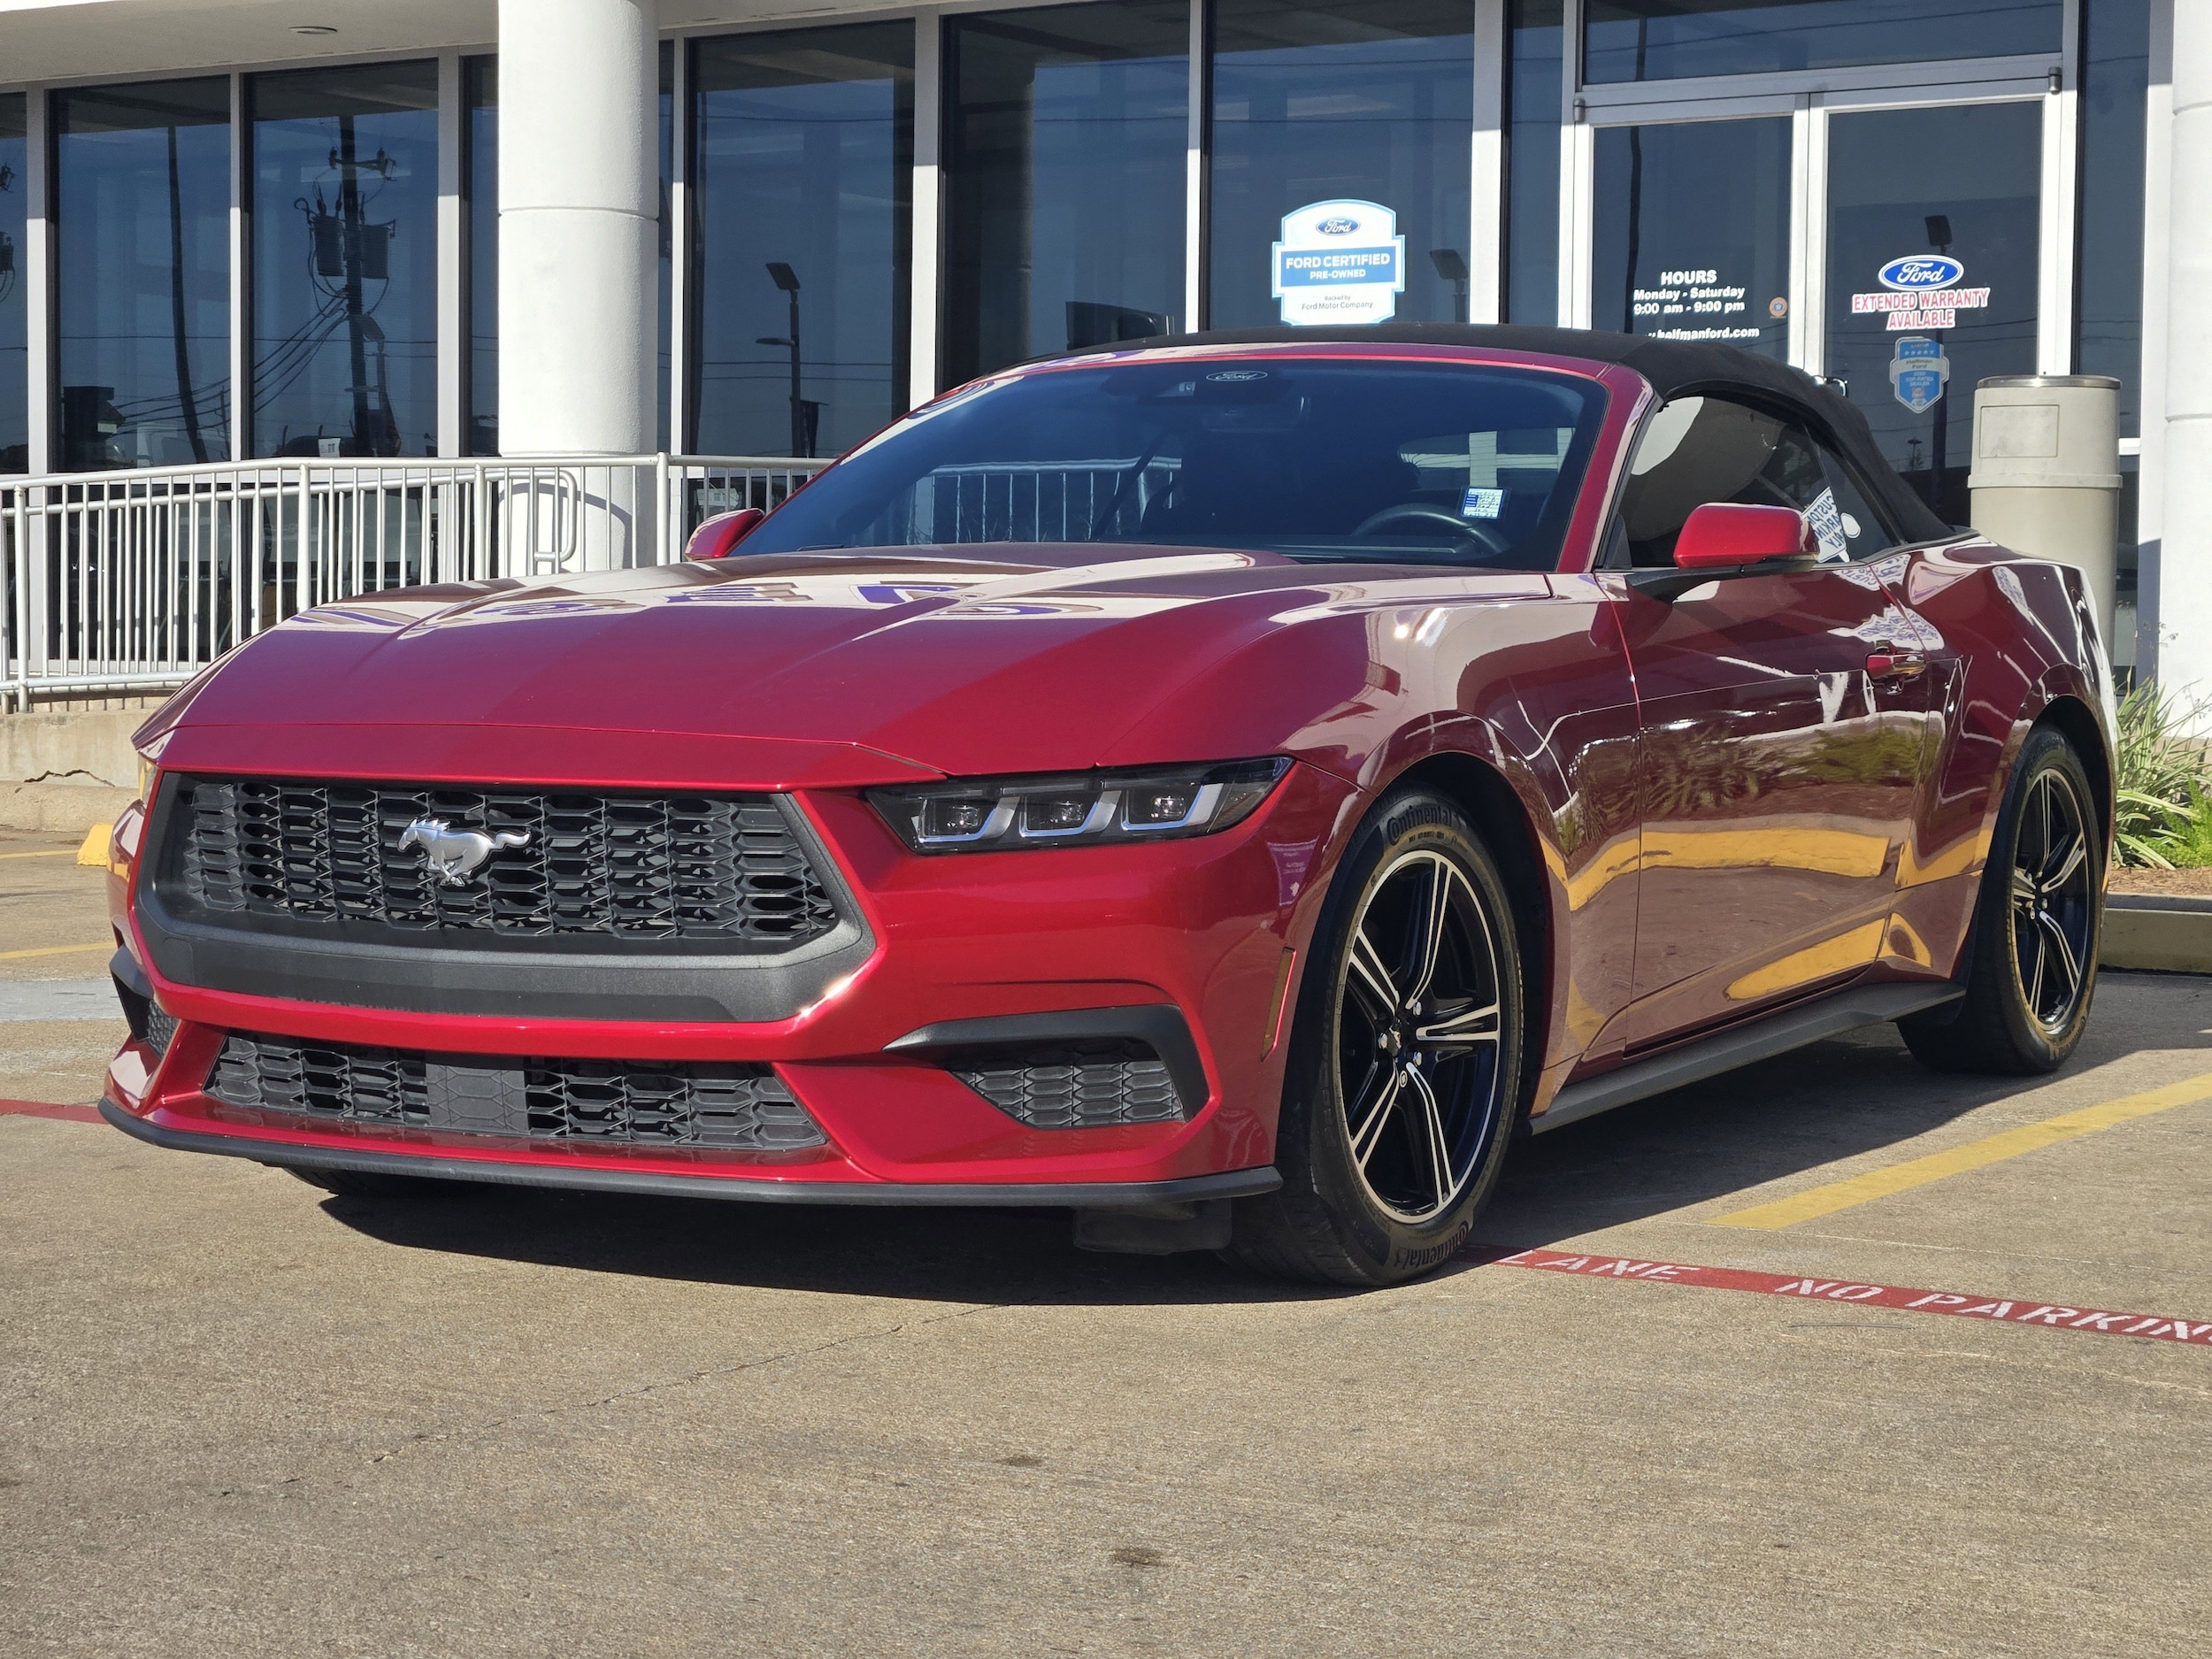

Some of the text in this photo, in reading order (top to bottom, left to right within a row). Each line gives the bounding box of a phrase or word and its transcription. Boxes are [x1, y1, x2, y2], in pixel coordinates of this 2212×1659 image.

[1286, 253, 1391, 270] FORD CERTIFIED
[1310, 269, 1366, 280] PRE-OWNED
[1660, 269, 1717, 286] HOURS
[1896, 261, 1946, 284] Ford
[1633, 288, 1681, 302] Monday
[1690, 286, 1745, 299] Saturday
[1854, 289, 1990, 311] EXTENDED WARRANTY
[1340, 301, 1373, 310] Company
[1633, 303, 1660, 315] 9:00
[1663, 303, 1684, 314] am
[1694, 301, 1722, 312] 9:00
[1724, 301, 1745, 314] pm
[1888, 311, 1955, 329] AVAILABLE
[1648, 326, 1760, 342] helfmanford.com
[1386, 805, 1453, 846] Continental
[1498, 1248, 2212, 1341] LANE NO PARKIN
